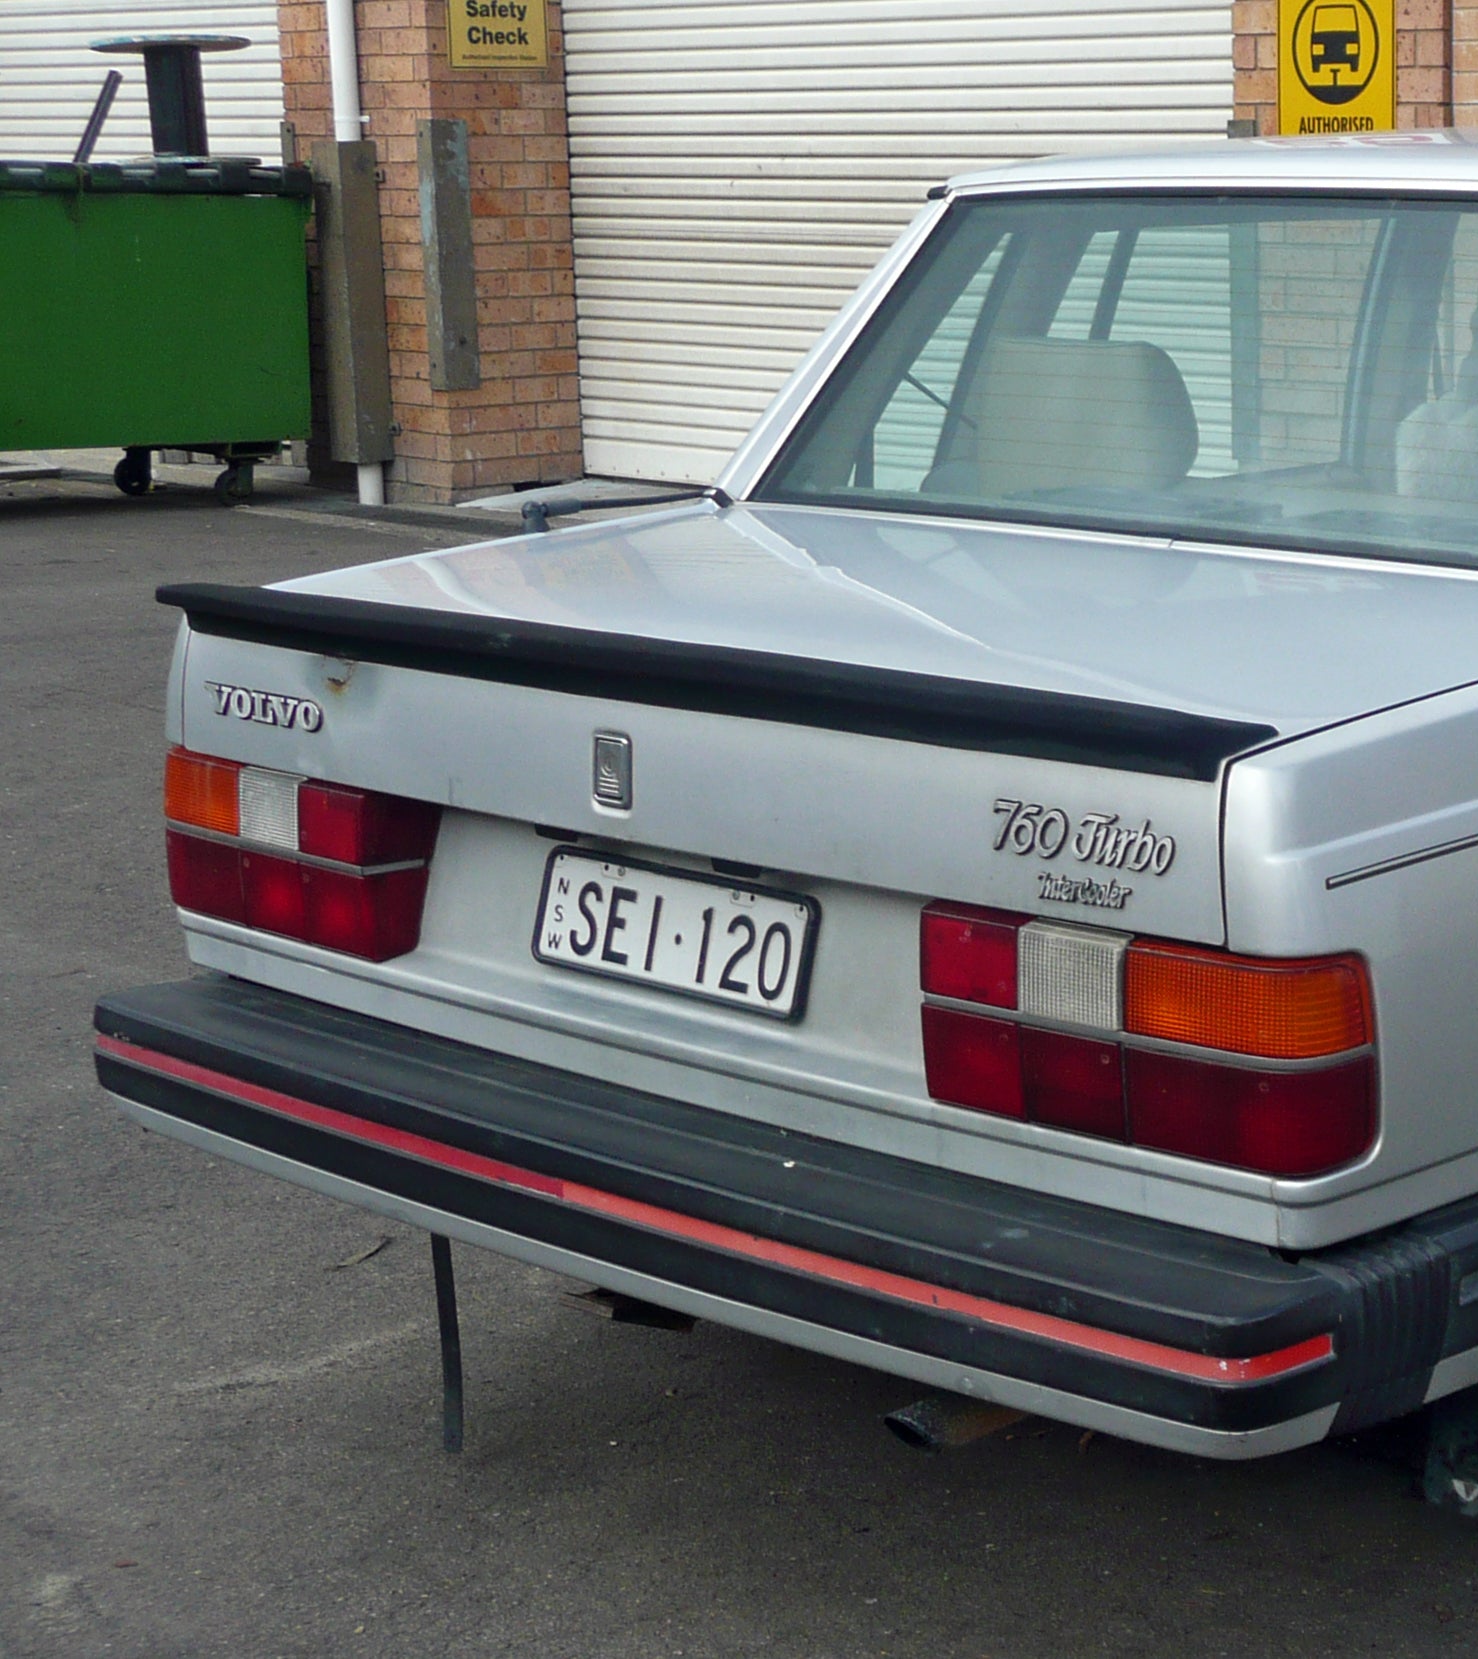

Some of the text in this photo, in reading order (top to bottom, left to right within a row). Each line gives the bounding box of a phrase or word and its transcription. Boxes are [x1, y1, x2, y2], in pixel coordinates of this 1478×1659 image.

[465, 0, 527, 21] Safety
[466, 26, 529, 46] Check
[1299, 116, 1374, 135] AUTHORISED
[204, 681, 324, 734] VOLVO
[993, 798, 1175, 876] 760 Turbo
